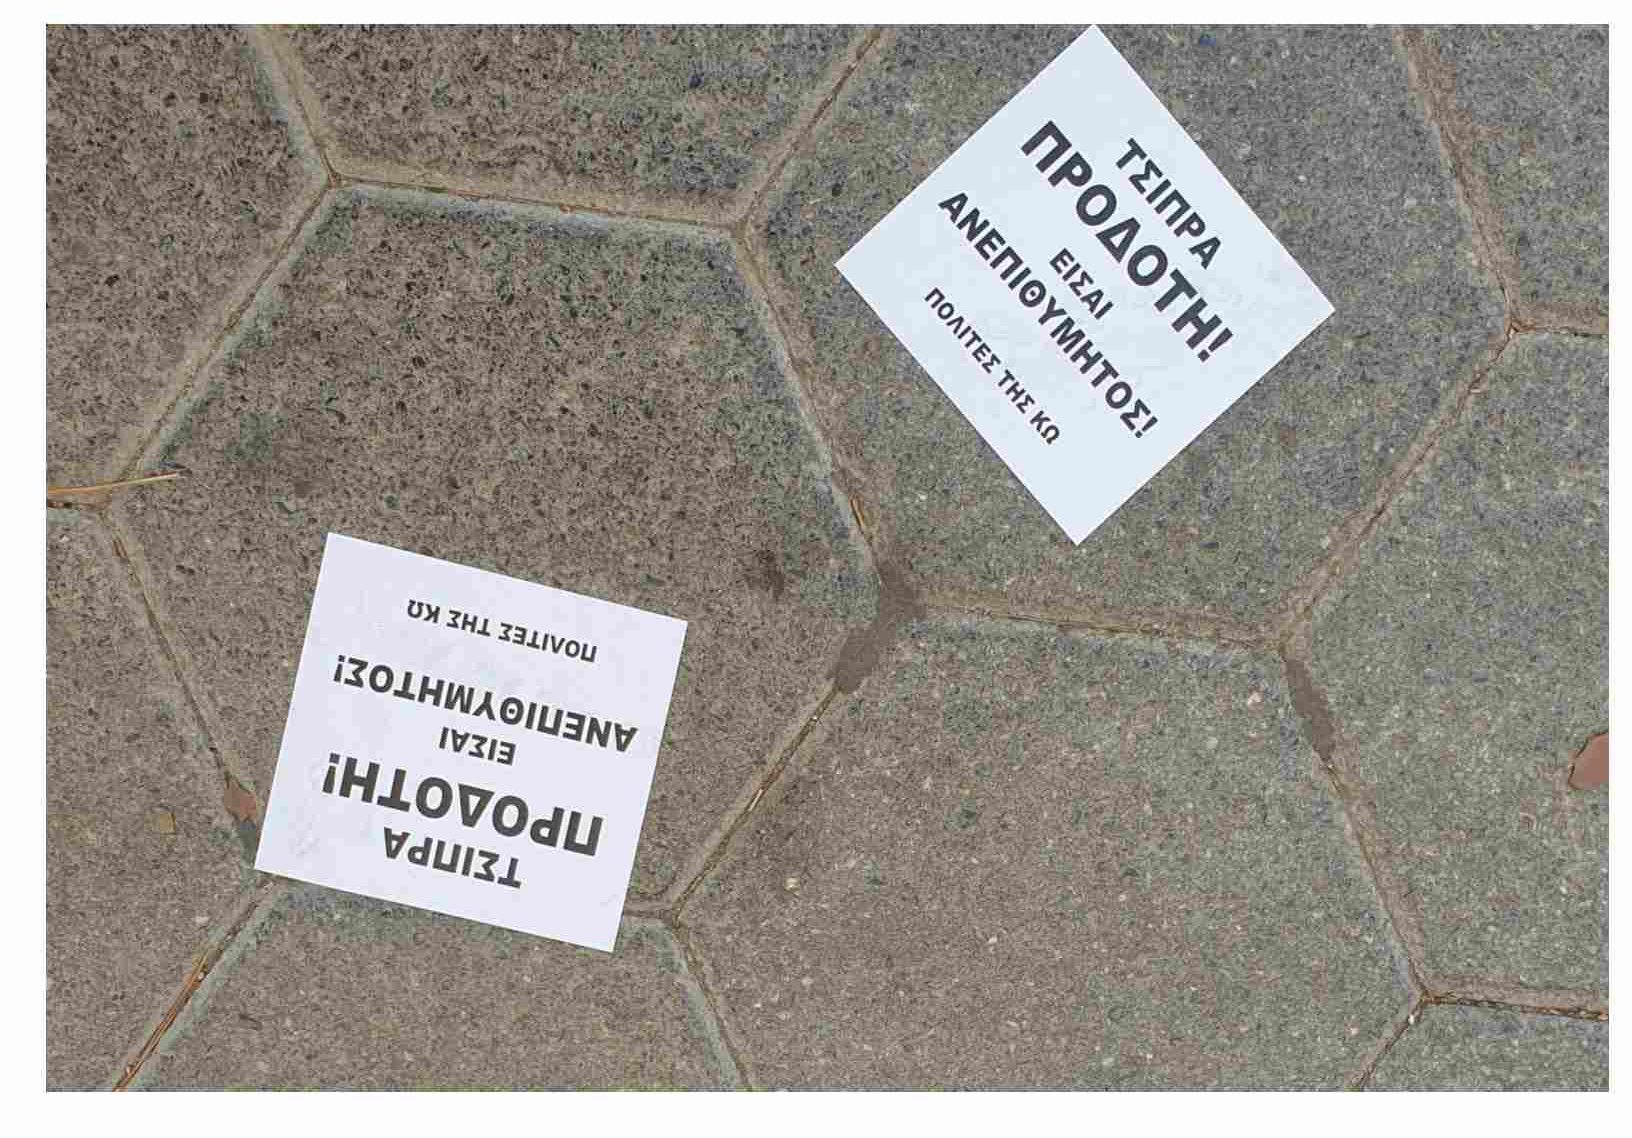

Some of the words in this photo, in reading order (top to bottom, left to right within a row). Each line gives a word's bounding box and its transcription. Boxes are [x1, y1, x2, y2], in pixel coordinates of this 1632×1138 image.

[1021, 120, 1233, 363] ΠΡΟΔΟΤΗ!
[1115, 137, 1221, 270] ΤΣΙΠΡΑ
[938, 192, 1158, 440] ΑΝΕΠΙΘΥΜΗΤΟΣ!
[1049, 247, 1114, 320] ΕΙΣΑΙ
[924, 287, 1001, 374] ΠΟΛΙΤΕΣ
[997, 369, 1035, 415] ΤΗΣ
[1029, 410, 1061, 445] ΚΩ
[407, 599, 441, 624] ΚΩ
[446, 609, 491, 637] ΤΗΣ
[497, 622, 598, 663] ΠΟΛΙΤΕΣ
[333, 654, 639, 753] ΑΝΕΠΙΘΥΜΗΤΟΣ!
[438, 726, 517, 766] ΕΙΣΑΙ
[321, 752, 604, 857] ΠΡΟΔΟΤΗ!
[383, 826, 522, 889] ΤΣΙΠΡΑ
